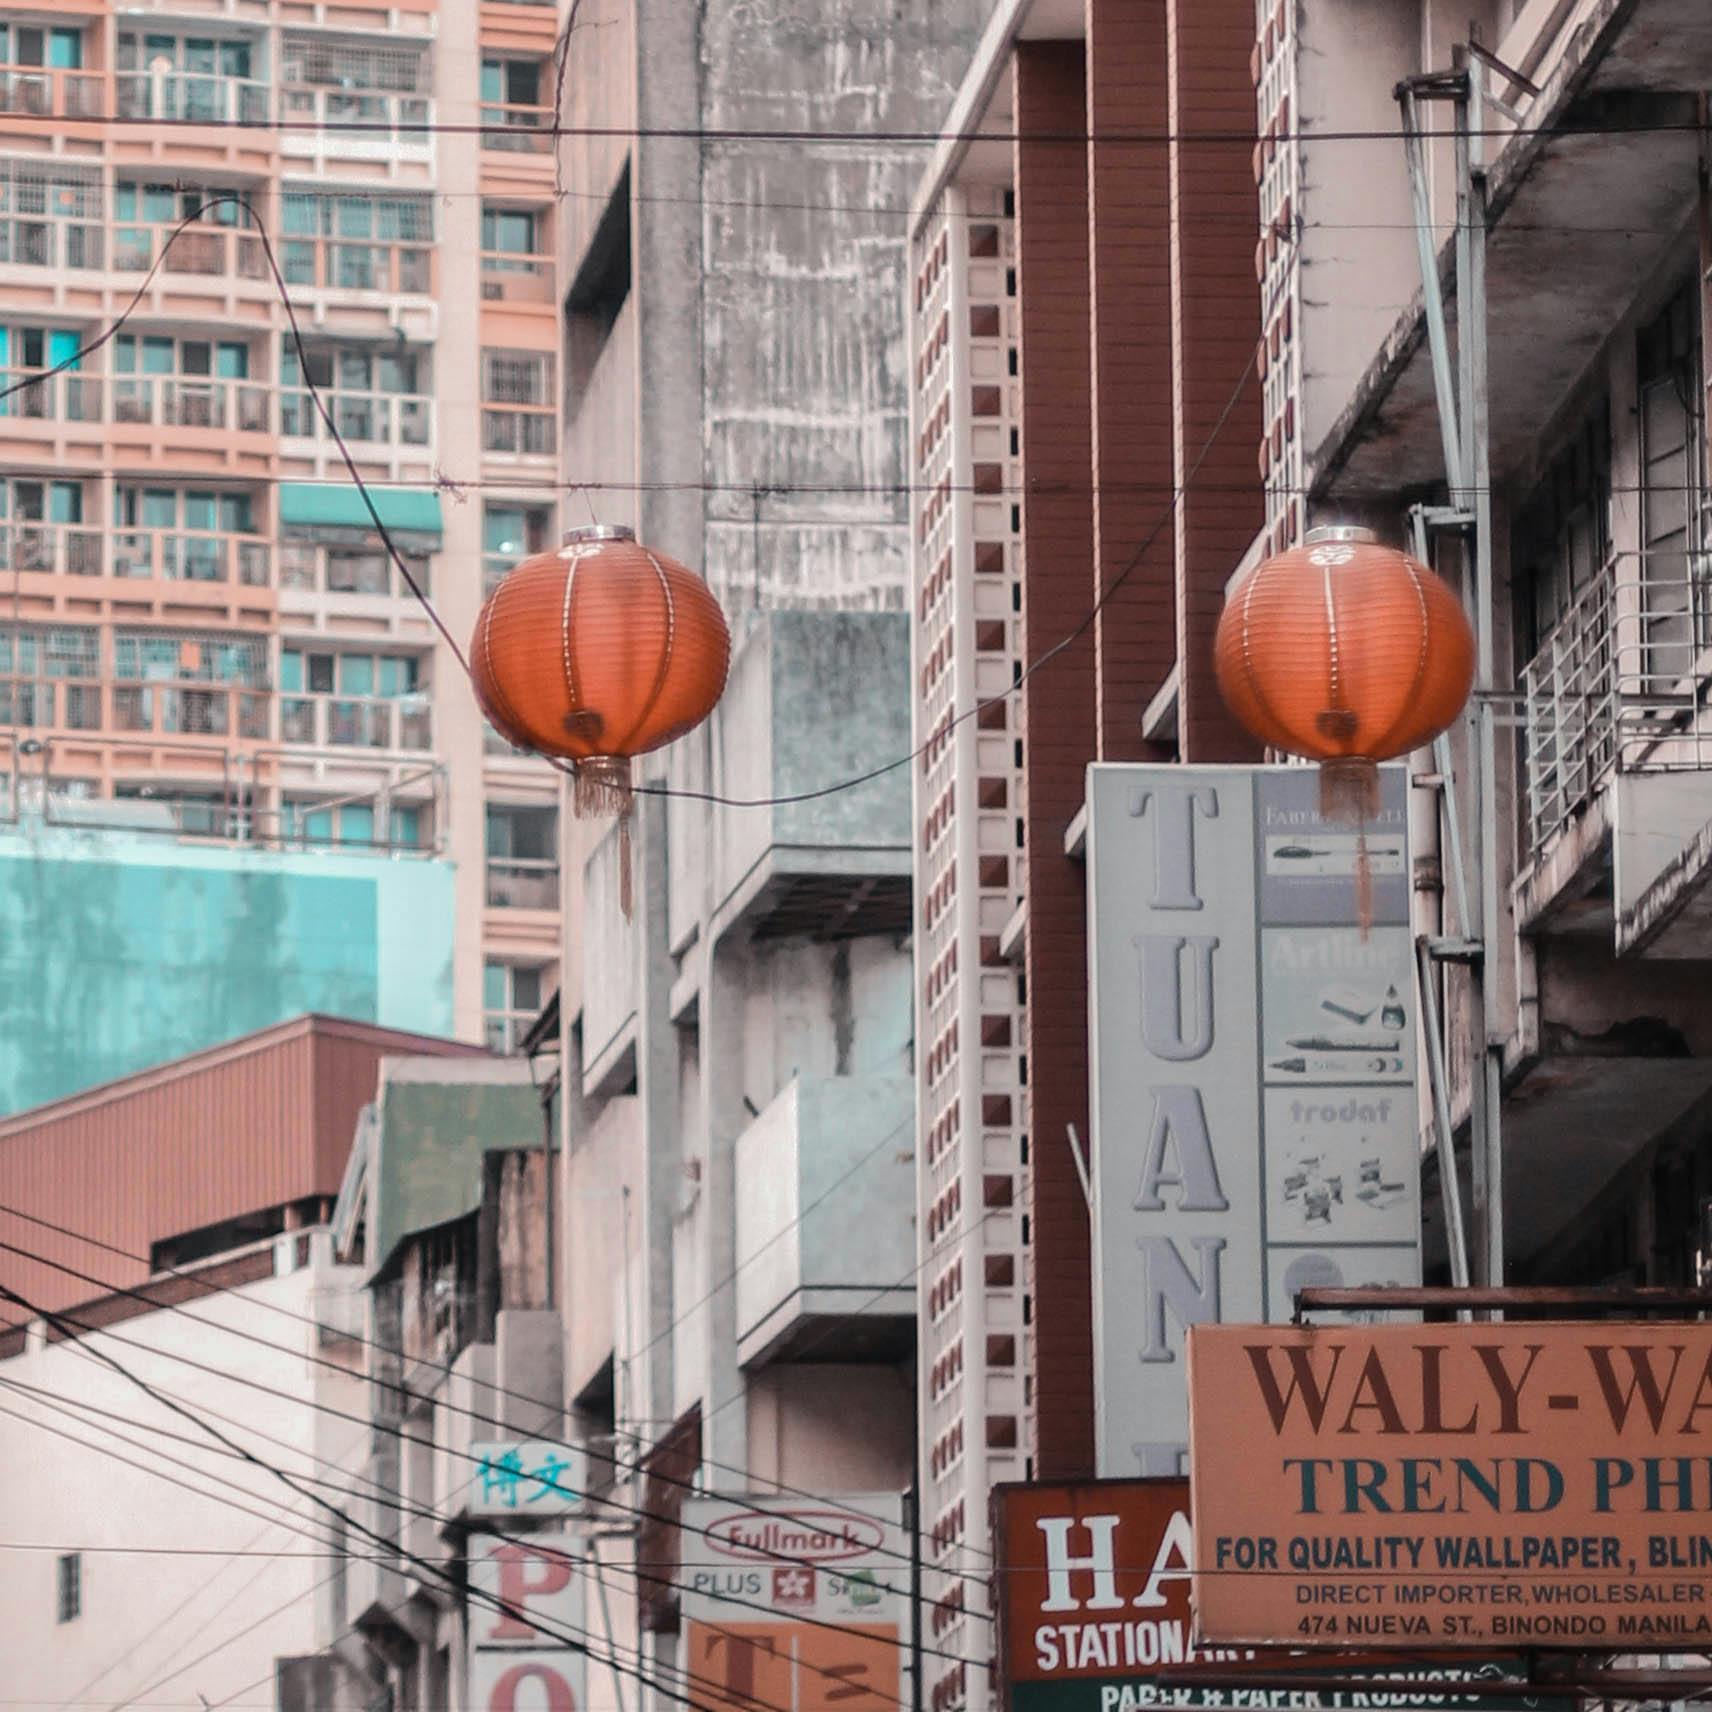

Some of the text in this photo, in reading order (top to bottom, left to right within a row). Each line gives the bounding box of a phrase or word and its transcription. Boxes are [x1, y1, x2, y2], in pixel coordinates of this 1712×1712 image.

[1283, 1456, 1565, 1514] TREND
[728, 1523, 860, 1552] Fullmark
[1216, 1536, 1280, 1570] FOR
[1288, 1536, 1425, 1572] QUALITY
[694, 1572, 762, 1595] PLUS
[1297, 1583, 1385, 1606] DIRECT
[1297, 1616, 1712, 1638] 474 NUEVA ST., BINONDO MANILA
[1035, 1621, 1255, 1671] STATION
